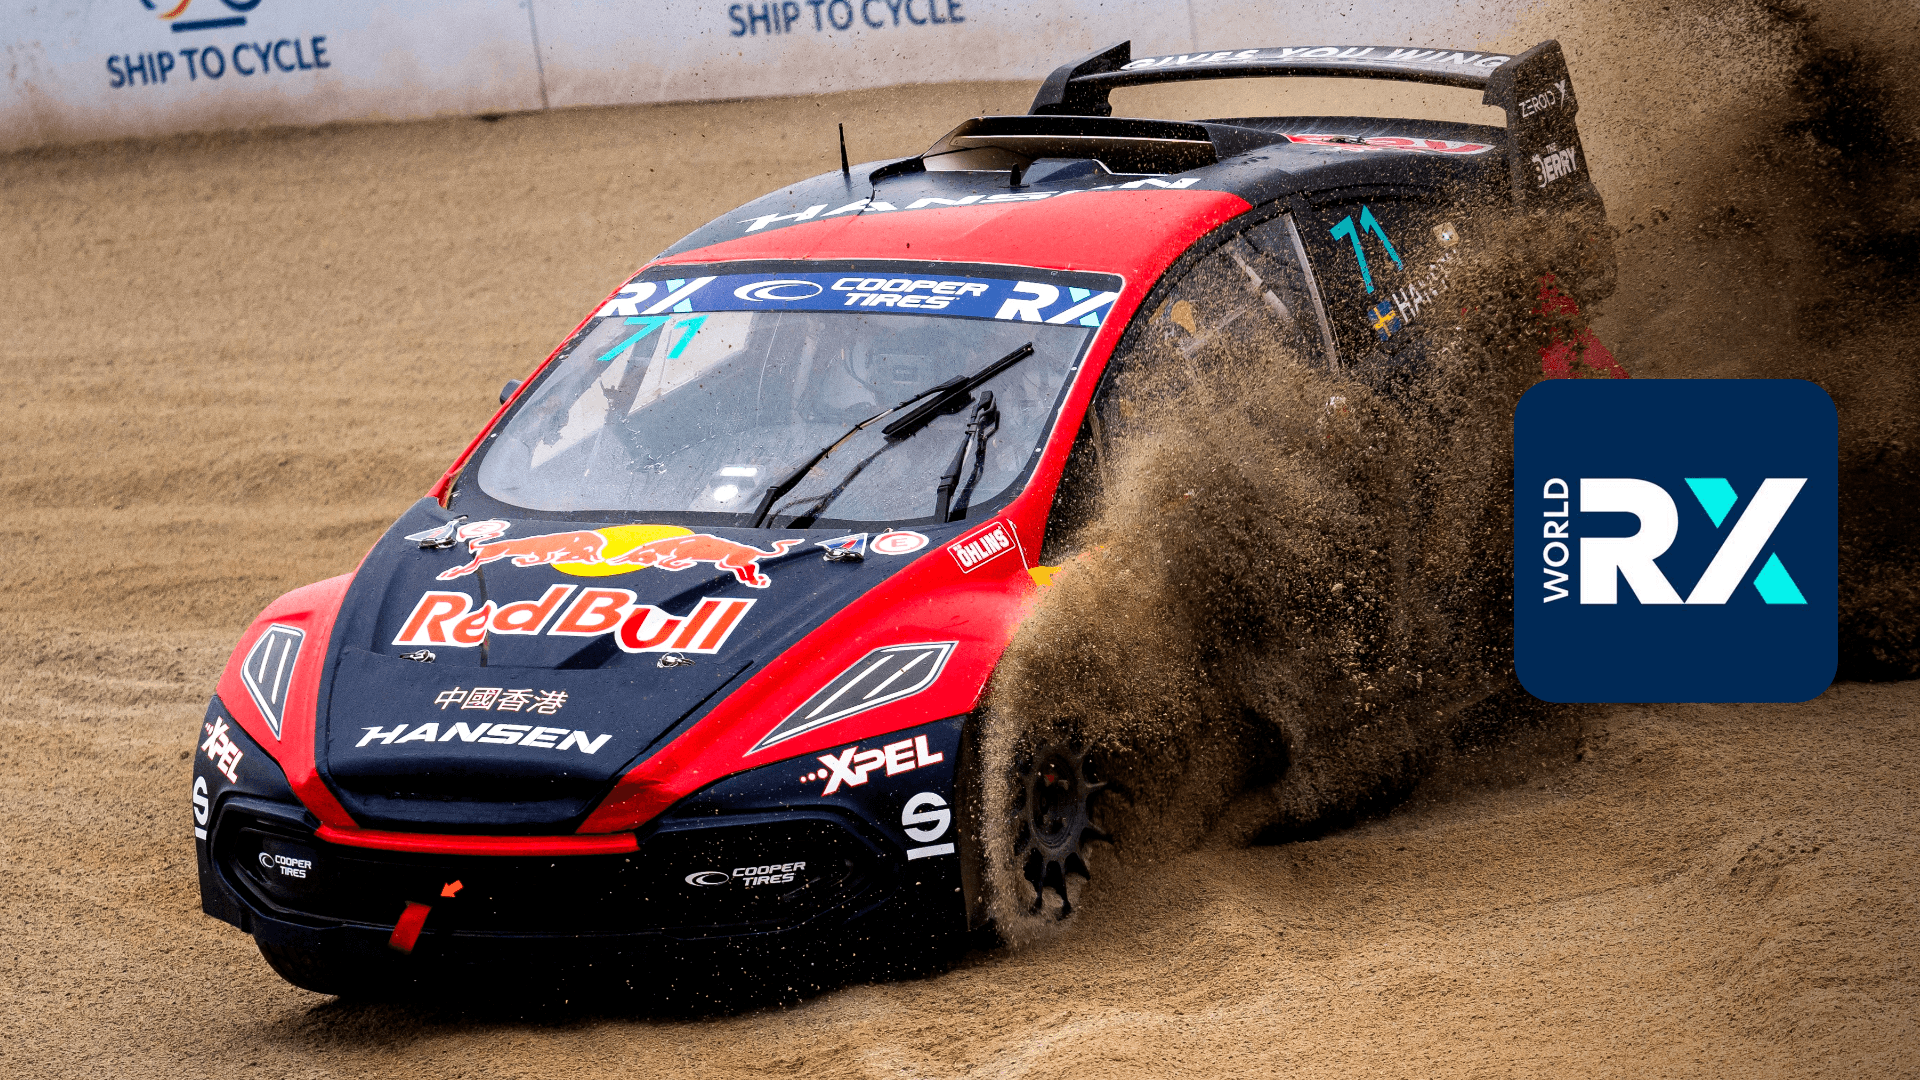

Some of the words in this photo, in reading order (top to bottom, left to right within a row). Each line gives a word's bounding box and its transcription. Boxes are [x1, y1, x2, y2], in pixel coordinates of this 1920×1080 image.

[728, 2, 800, 37] SHIP
[806, 0, 854, 32] TO
[861, 0, 966, 29] CYCLE
[106, 50, 175, 88] SHIP
[179, 45, 226, 81] TO
[232, 35, 331, 77] CYCLE
[1120, 49, 1260, 71] GIVES
[1279, 46, 1376, 59] YOU
[1328, 204, 1404, 294] 71
[594, 275, 719, 317] RX
[831, 277, 989, 297] COOPER
[844, 292, 957, 310] TIRES
[994, 280, 1120, 327] RX
[597, 314, 709, 362] 71
[952, 526, 1009, 568] ÖHLINS
[393, 584, 578, 647] Red
[547, 588, 757, 655] Bull
[434, 686, 569, 715] 中國香港
[200, 715, 244, 785] XPEL
[355, 722, 613, 755] HANSEN
[816, 734, 944, 797] XPEL
[274, 854, 312, 870] COOPER
[280, 865, 307, 879] TIRES
[732, 861, 807, 877] COOPER
[742, 872, 795, 887] TIRES
